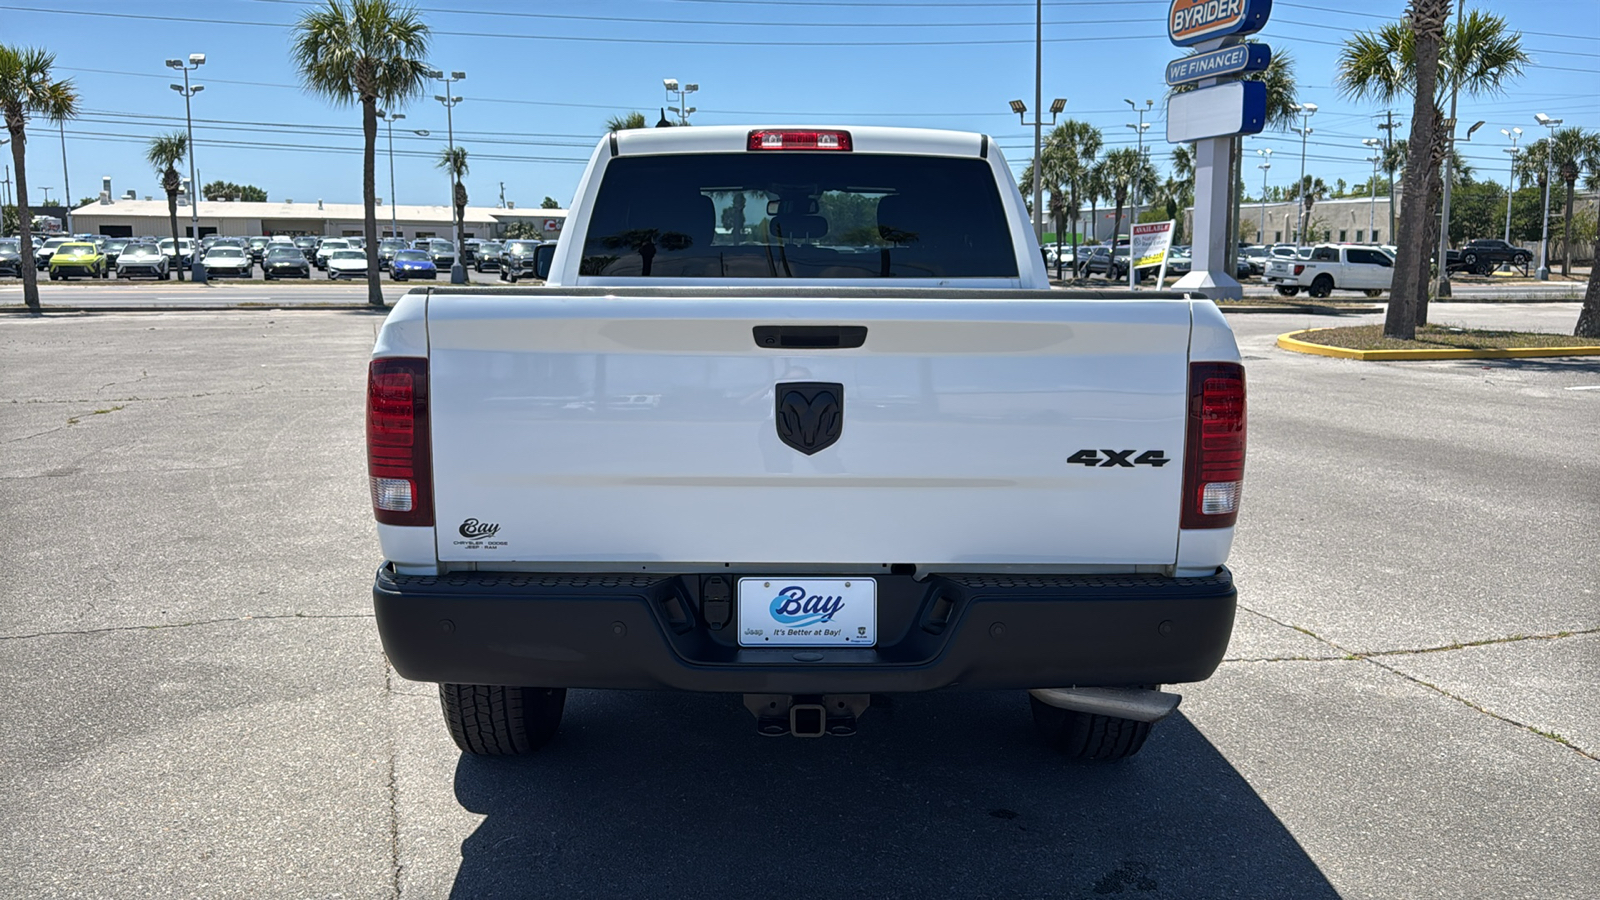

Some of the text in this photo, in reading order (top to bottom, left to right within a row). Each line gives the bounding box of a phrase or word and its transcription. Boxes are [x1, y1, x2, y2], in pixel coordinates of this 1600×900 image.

[1173, 0, 1239, 32] BYRIDER
[1170, 51, 1244, 79] WE FINANCE!
[1136, 225, 1169, 233] AVAILABLE
[461, 518, 501, 538] Bay
[775, 585, 845, 623] Bay
[773, 628, 786, 636] It's
[787, 628, 812, 636] Better
[823, 628, 842, 637] Bay!
